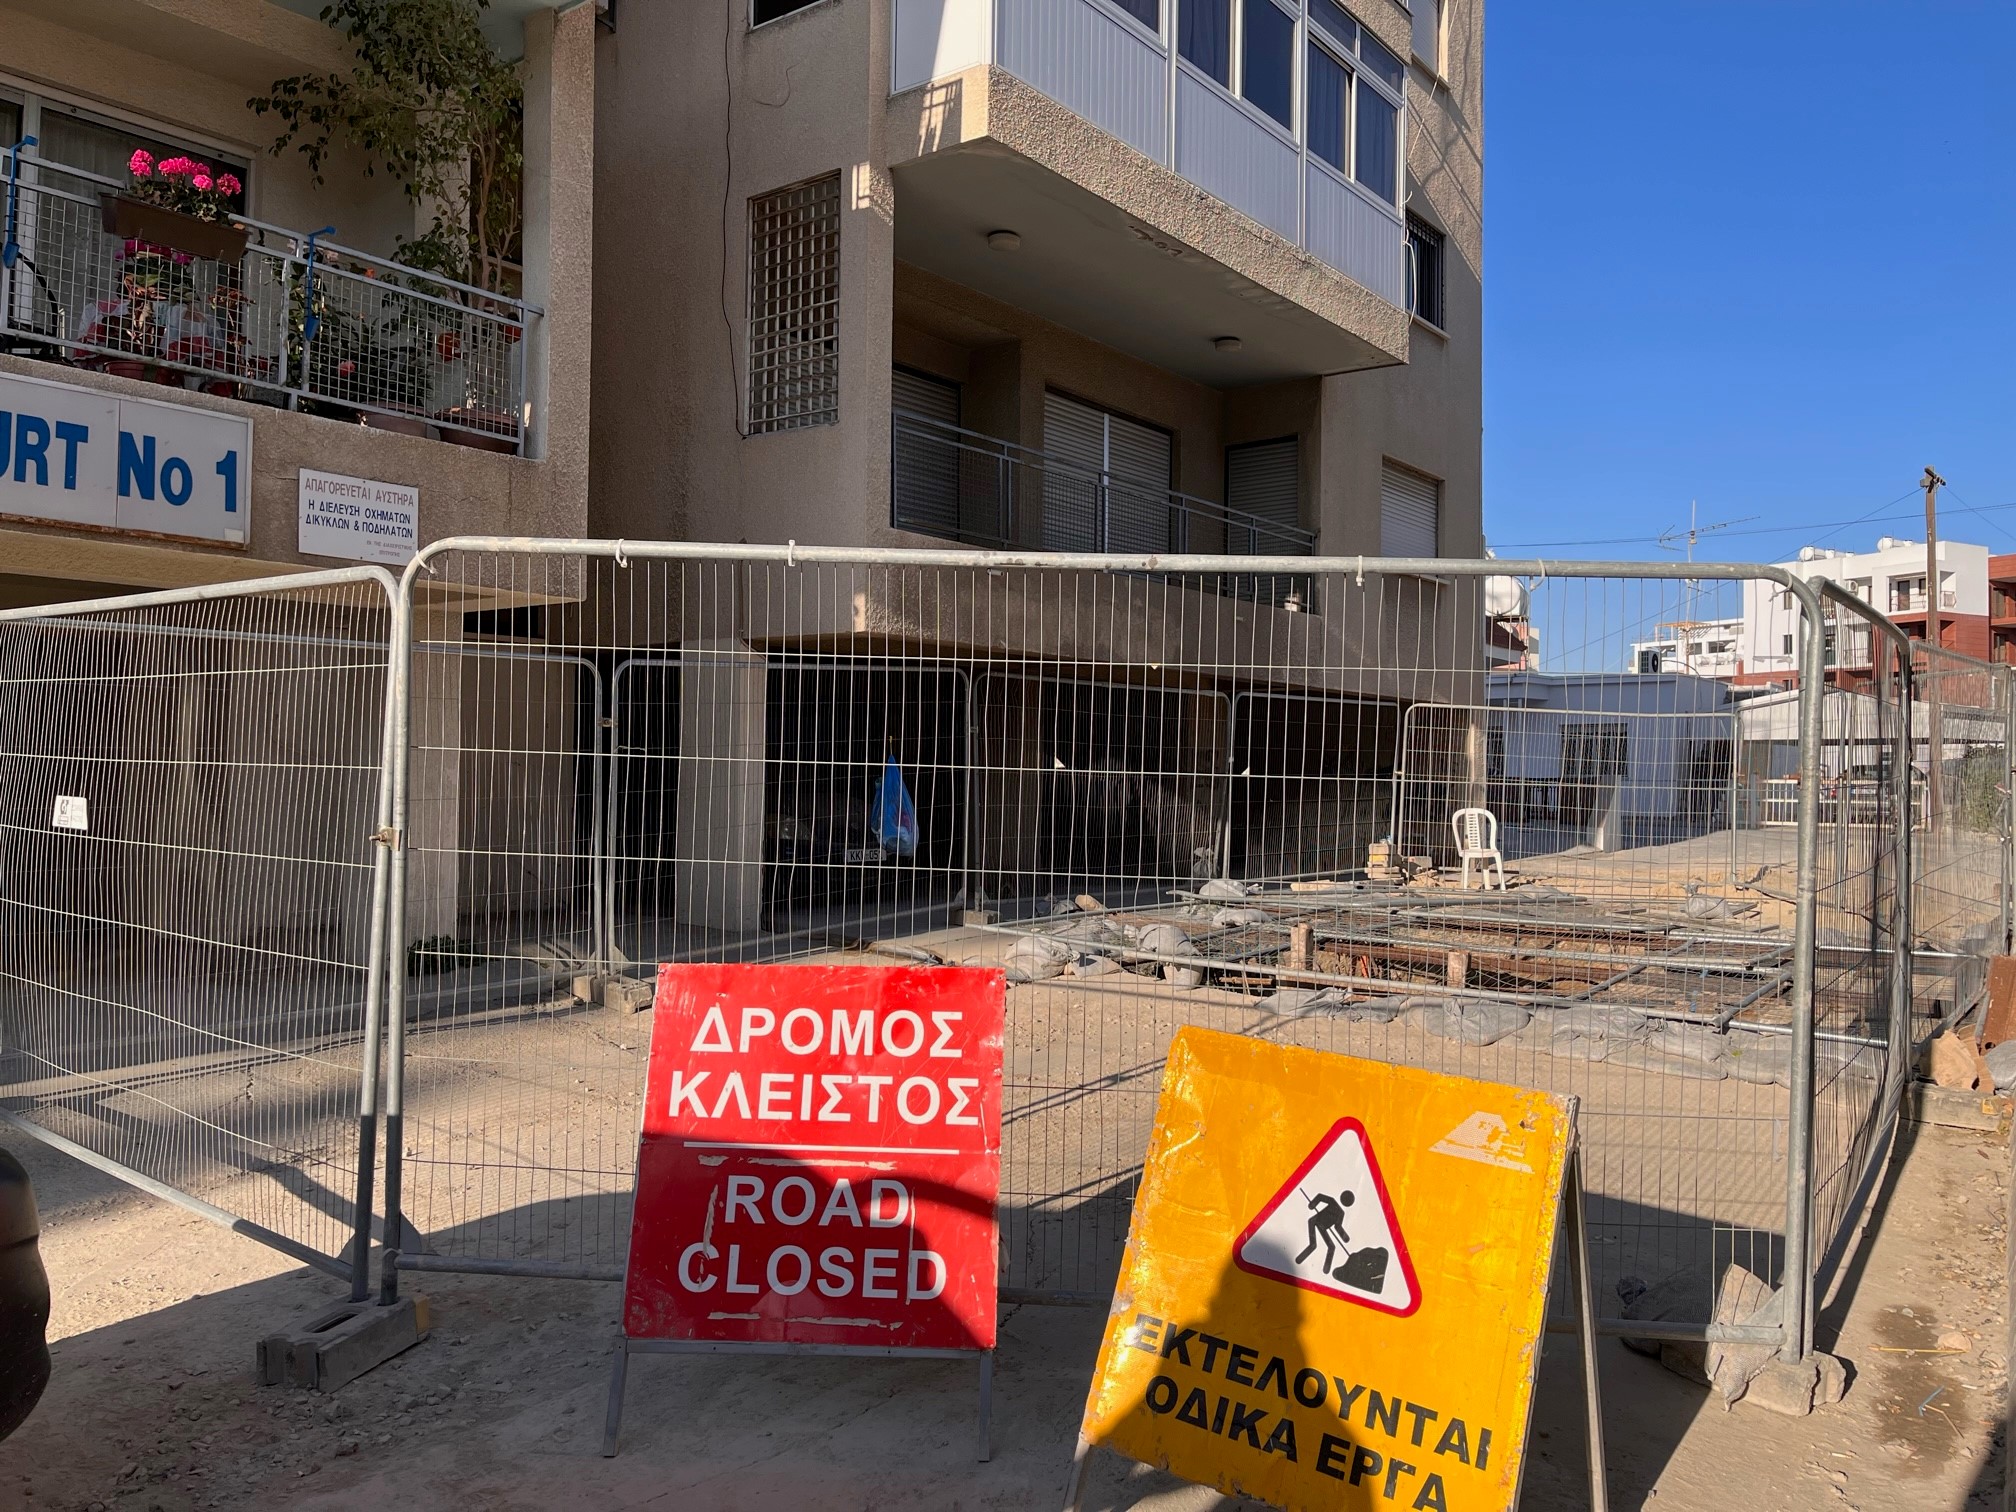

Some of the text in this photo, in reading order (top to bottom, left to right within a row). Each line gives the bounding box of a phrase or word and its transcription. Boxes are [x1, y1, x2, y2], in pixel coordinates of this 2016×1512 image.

[119, 431, 193, 506] No
[216, 450, 237, 512] 1
[305, 478, 414, 507] ΑΠΑΓΟΡΕΥΕΤΑΙ ΑΥΣΤΗΡΑ
[305, 513, 413, 538] ΔΙΚΥΚΛΩΝ & ΠΟΔΗΛΑΤΩΝ
[308, 499, 411, 524] Η ΔΙΕΛΕΥΣΗ ΟΧΗΜΑΤΩΝ
[690, 1006, 963, 1058] ΔΡΟΜΟΣ
[668, 1070, 979, 1126] ΚΛΕΙΣΤΟΣ
[724, 1175, 910, 1228] ROAD
[678, 1242, 947, 1300] CLOSED
[1130, 1313, 1492, 1471] ΕΚΤΕΛΟΥΝΤΑΙ
[1145, 1375, 1448, 1512] ΟΔΙΚΑ ΕΡΓΑ
